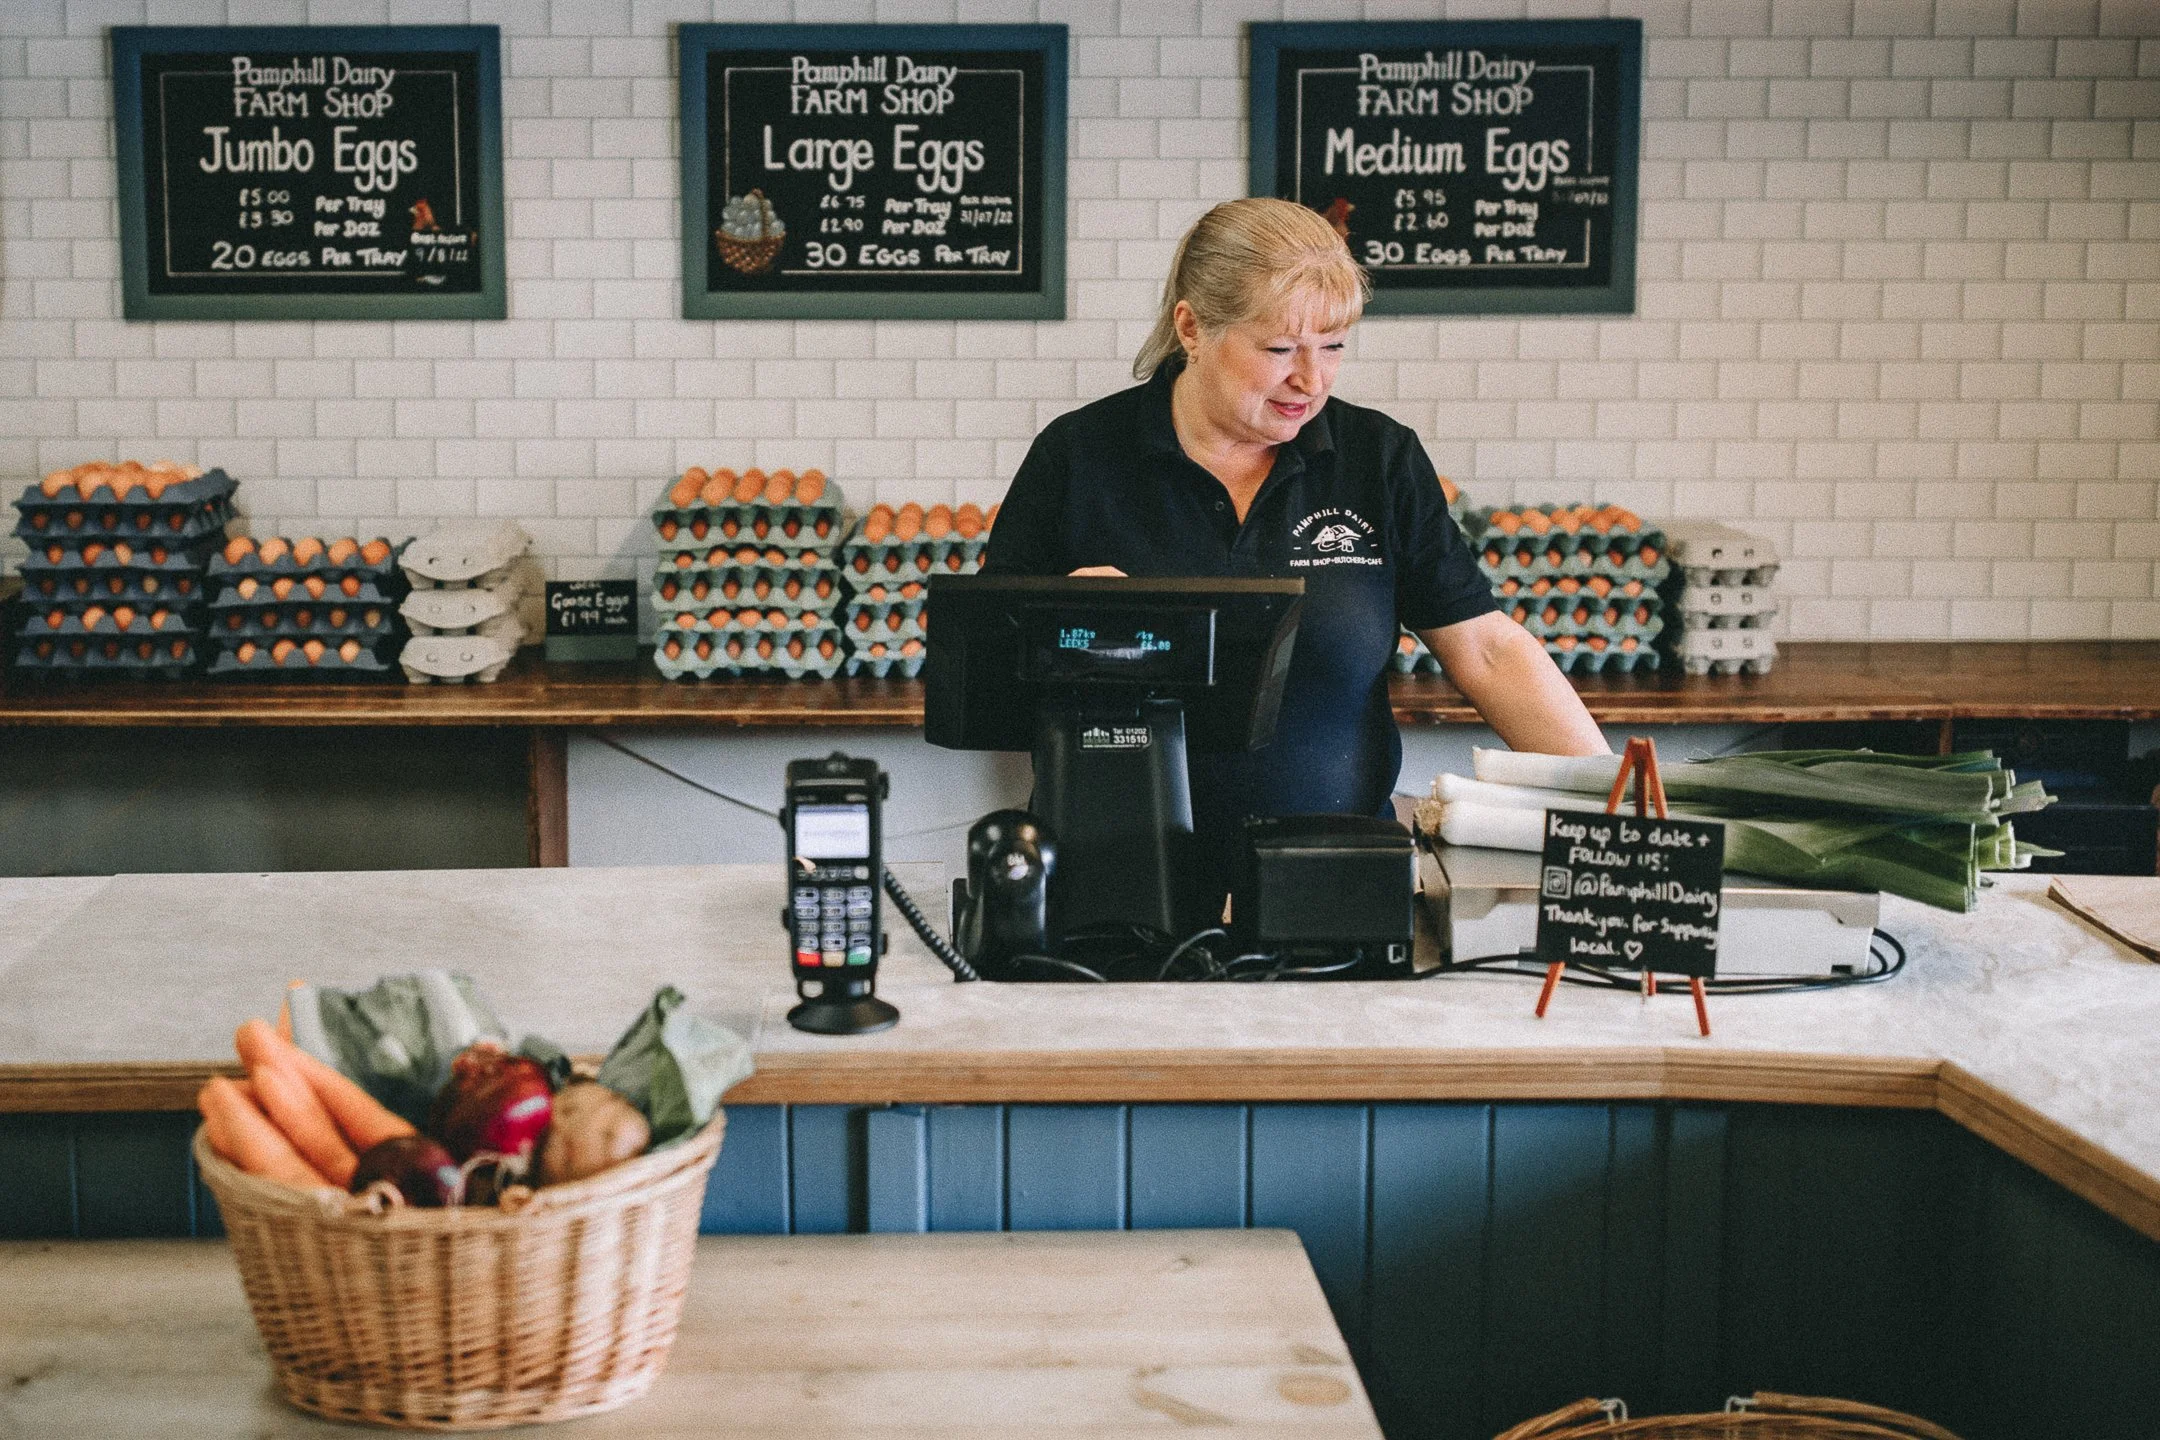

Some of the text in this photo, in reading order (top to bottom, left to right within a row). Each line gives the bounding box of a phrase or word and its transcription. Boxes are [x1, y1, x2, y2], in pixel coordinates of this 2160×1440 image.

[232, 56, 397, 90] Pamphill Dairy
[791, 56, 957, 89] Pamphill Dairy
[1358, 50, 1535, 90] Pamphill Dairy
[233, 87, 394, 118] FARM SHOP
[790, 84, 955, 115] FARM SHOP
[1357, 81, 1534, 117] FARM SHOP
[199, 125, 418, 192] Jumbo Eggs
[763, 124, 985, 194] Large Eggs
[1324, 126, 1571, 191] Medium Eggs
[211, 240, 257, 270] 20
[805, 241, 848, 267] 30
[1364, 240, 1405, 265] 30
[1292, 508, 1375, 537] PAMPHILL DAIRY
[1059, 639, 1090, 649] LEEKS
[1550, 813, 1587, 844] Keep
[1589, 826, 1612, 848] up
[1619, 821, 1641, 843] to
[1647, 827, 1694, 847] date
[1544, 903, 1598, 927] Thank
[1632, 913, 1658, 934] for
